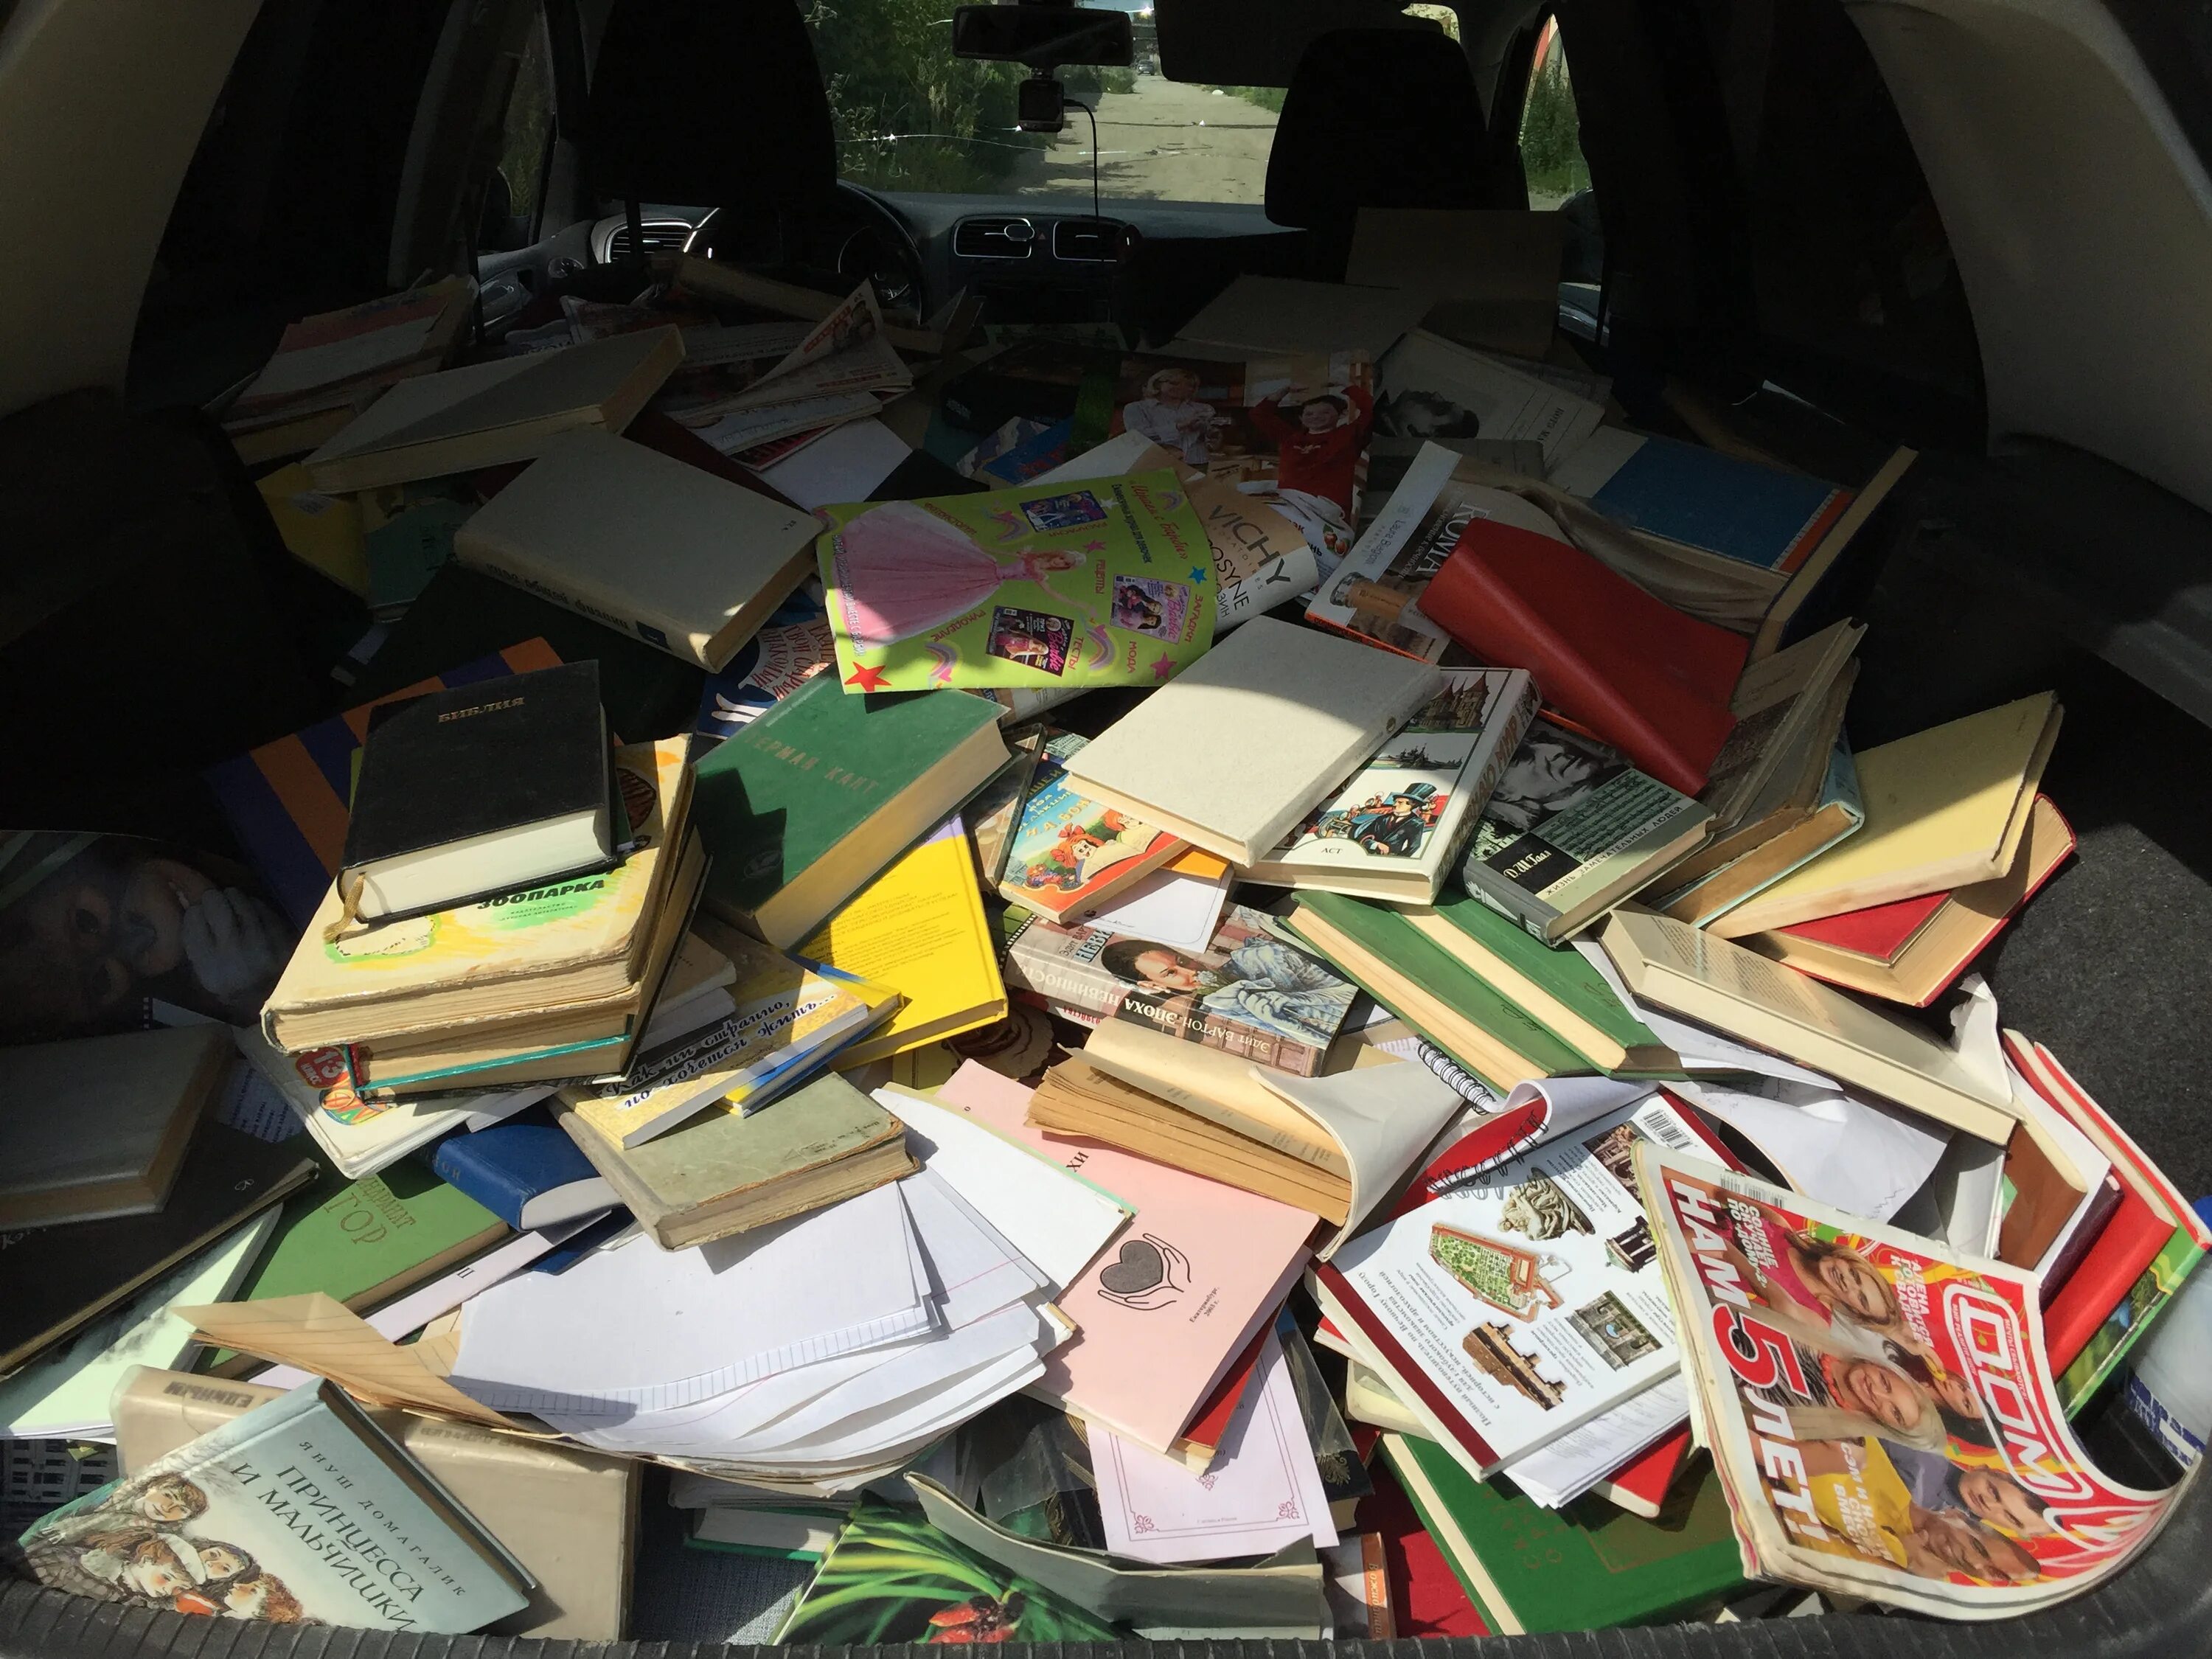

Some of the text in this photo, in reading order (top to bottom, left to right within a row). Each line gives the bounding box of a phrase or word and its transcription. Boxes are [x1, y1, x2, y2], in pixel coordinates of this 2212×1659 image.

[1209, 504, 1292, 585] VICHY
[845, 602, 860, 625] ВМЕСТЕ
[1068, 636, 1084, 670] ТЕСТЫ
[1127, 641, 1136, 673] МОДА
[437, 696, 526, 723] БИБЛИЯ
[1491, 714, 1523, 773] МИР
[1545, 804, 1683, 897] ЖИЗНЬ ЗАМЕЧАТЕЛЬНЫХ ЛЮДЕЙ
[1123, 997, 1179, 1025] ЭПОХА
[605, 997, 790, 1099] Как ни странно,
[622, 1088, 653, 1109] но
[662, 1037, 748, 1090] хочется
[1236, 1032, 1272, 1054] Эдит
[1727, 1198, 1743, 1222] ПО
[1738, 1201, 1770, 1269] СКУЧАЕТ
[1748, 1204, 1779, 1267] СОЛНЦЕ
[1377, 1270, 1421, 1318] археологией
[1888, 1252, 1926, 1343] К СВАДЬБЕ
[1902, 1259, 1935, 1346] ГОТОВИТСЯ
[1910, 1260, 1930, 1315] АЛЕНА
[1355, 1270, 1492, 1428] Полный путеводитель по Вечному Городу
[1386, 1295, 1475, 1394] для глубокого знакомства
[1422, 1323, 1461, 1367] искусством
[1669, 1180, 1830, 1543] НАМ 5 ЛЕТ!
[2003, 1318, 2015, 1347] МЕЧТЫ
[1458, 1365, 1496, 1405] историей,
[1961, 1289, 2076, 1500] ДОМ
[1840, 1441, 1863, 1482] СЭМ
[1855, 1484, 1870, 1503] И
[229, 1458, 418, 1635] И МАЛЬЧИШКИ
[274, 1464, 426, 1605] ПРИНЦЕССА
[298, 1438, 467, 1599] ЯНУШ ДОМАГАЛИК
